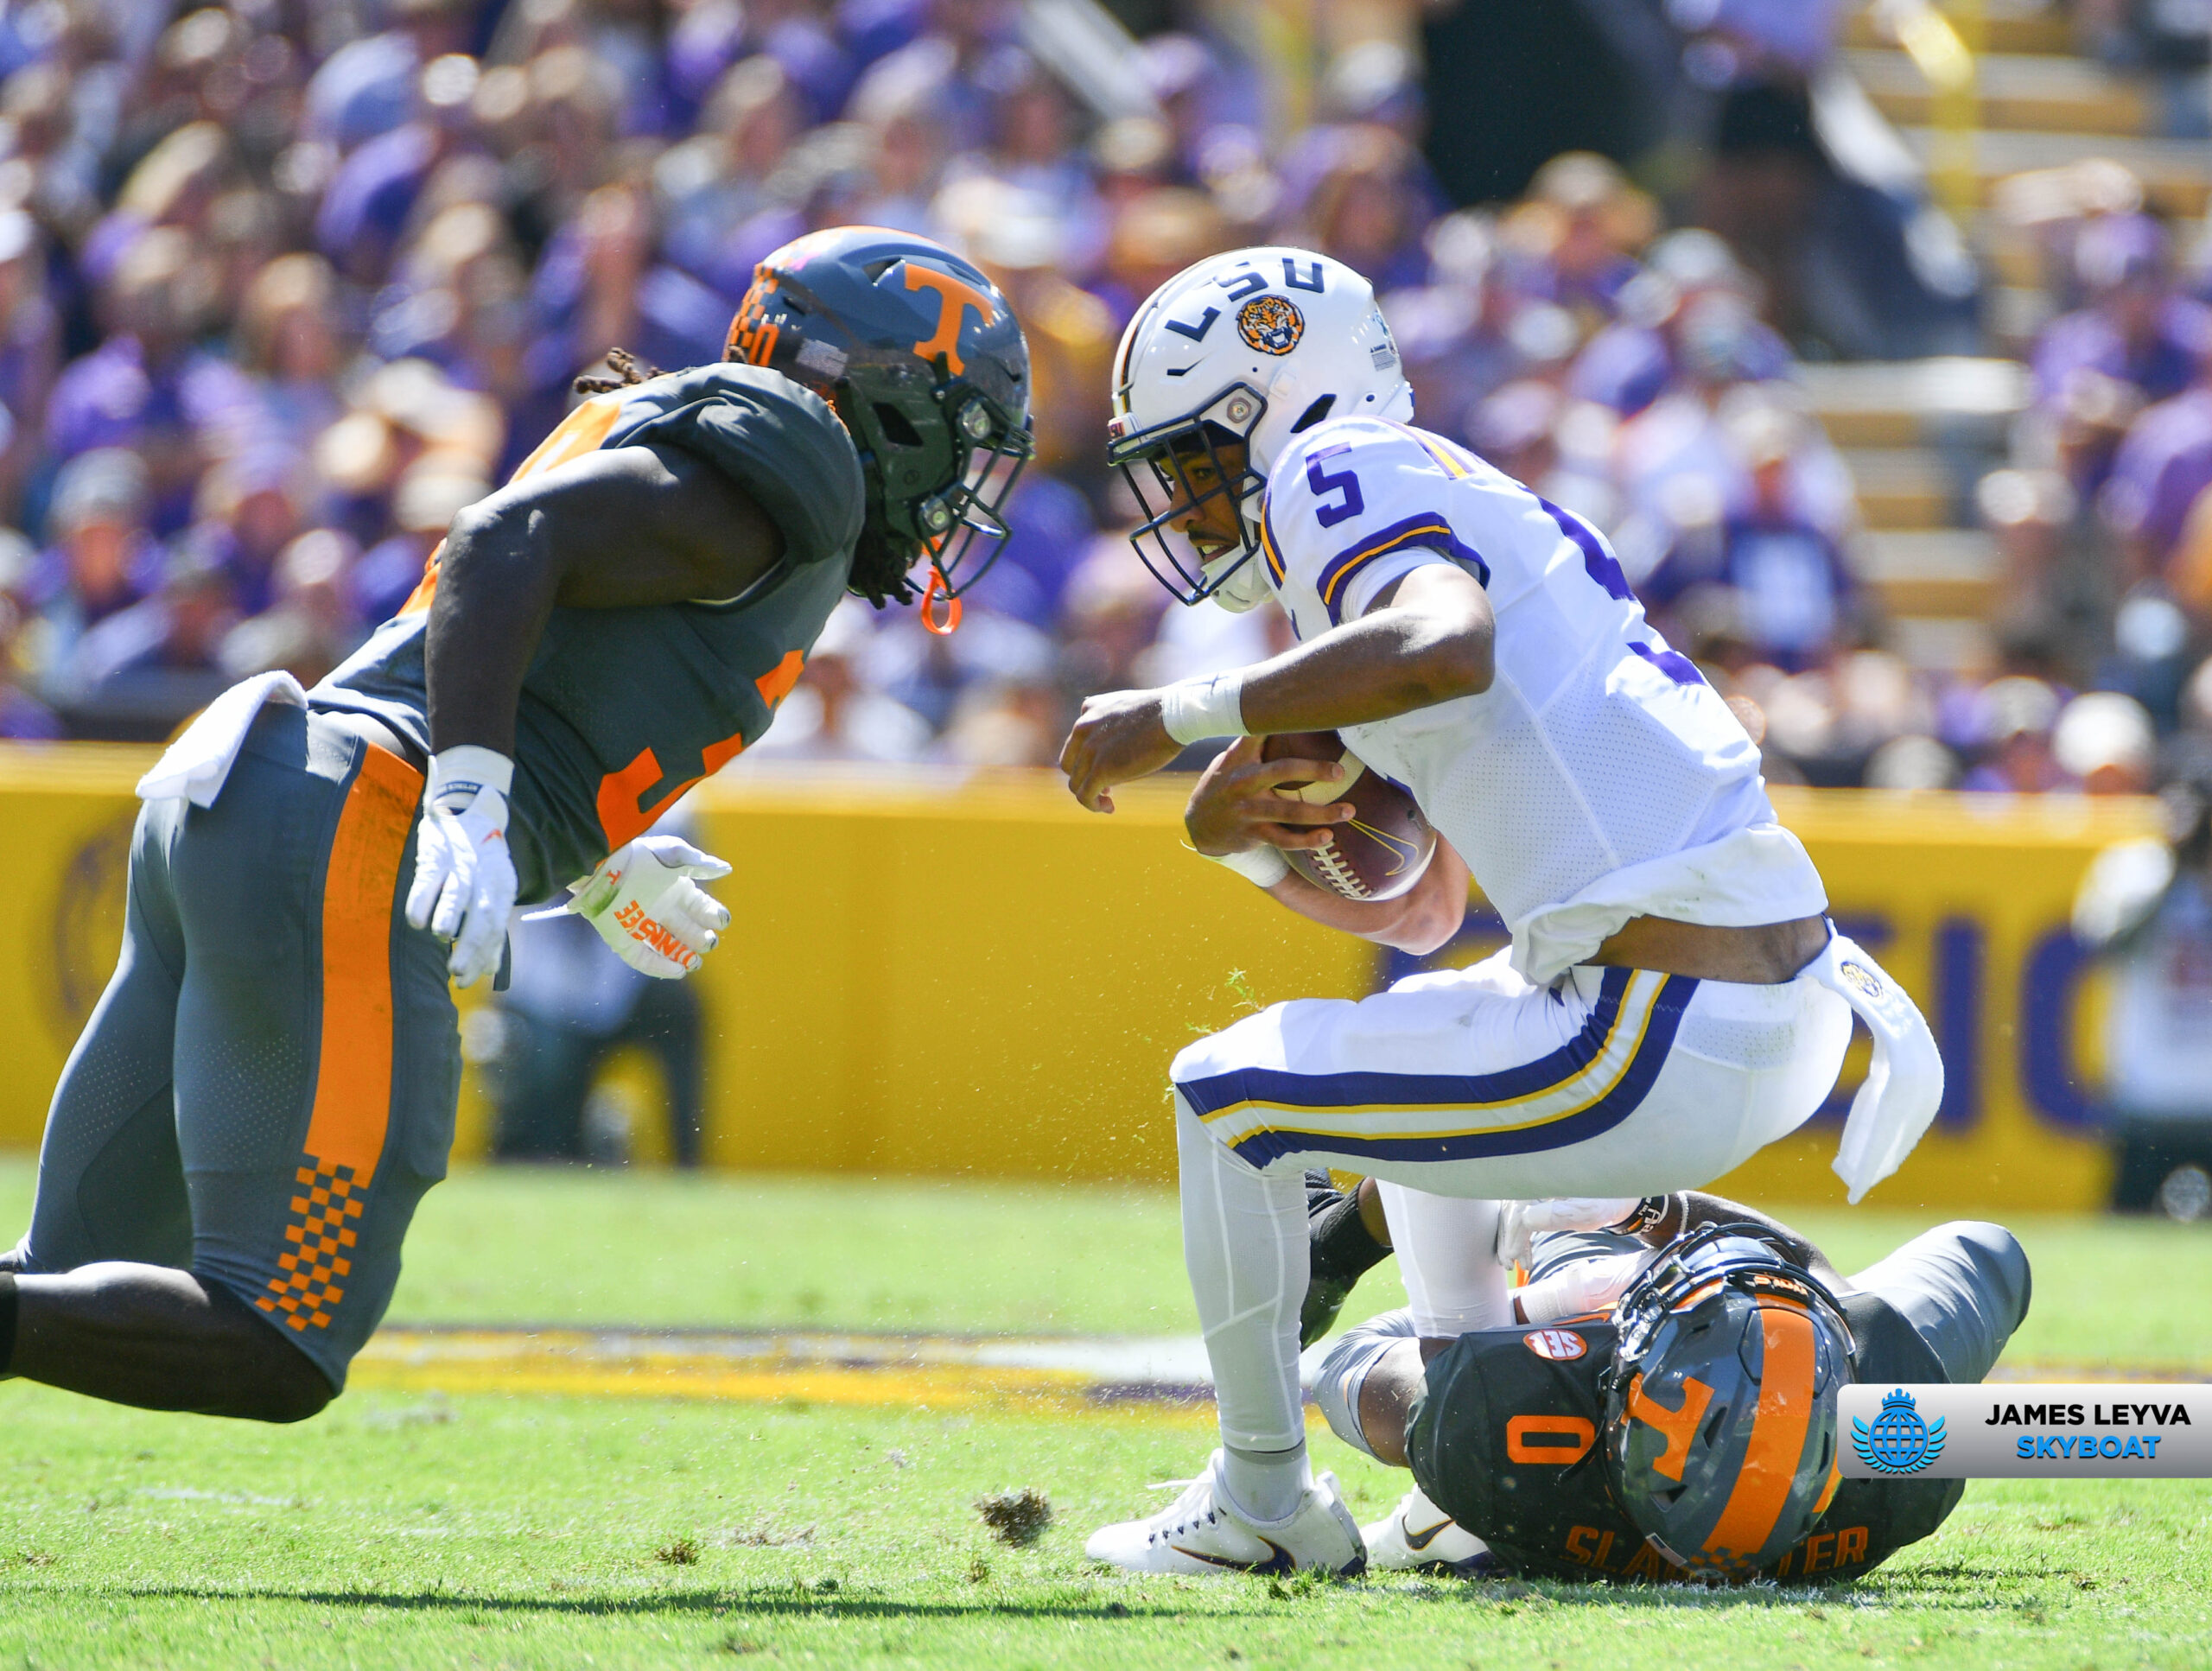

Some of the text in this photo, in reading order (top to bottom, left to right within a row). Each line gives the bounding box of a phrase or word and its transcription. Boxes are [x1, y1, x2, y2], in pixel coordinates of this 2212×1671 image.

[905, 263, 995, 377] T
[1164, 257, 1325, 342] LSU
[1306, 442, 1364, 528] 5
[1506, 1415, 1596, 1465] 0
